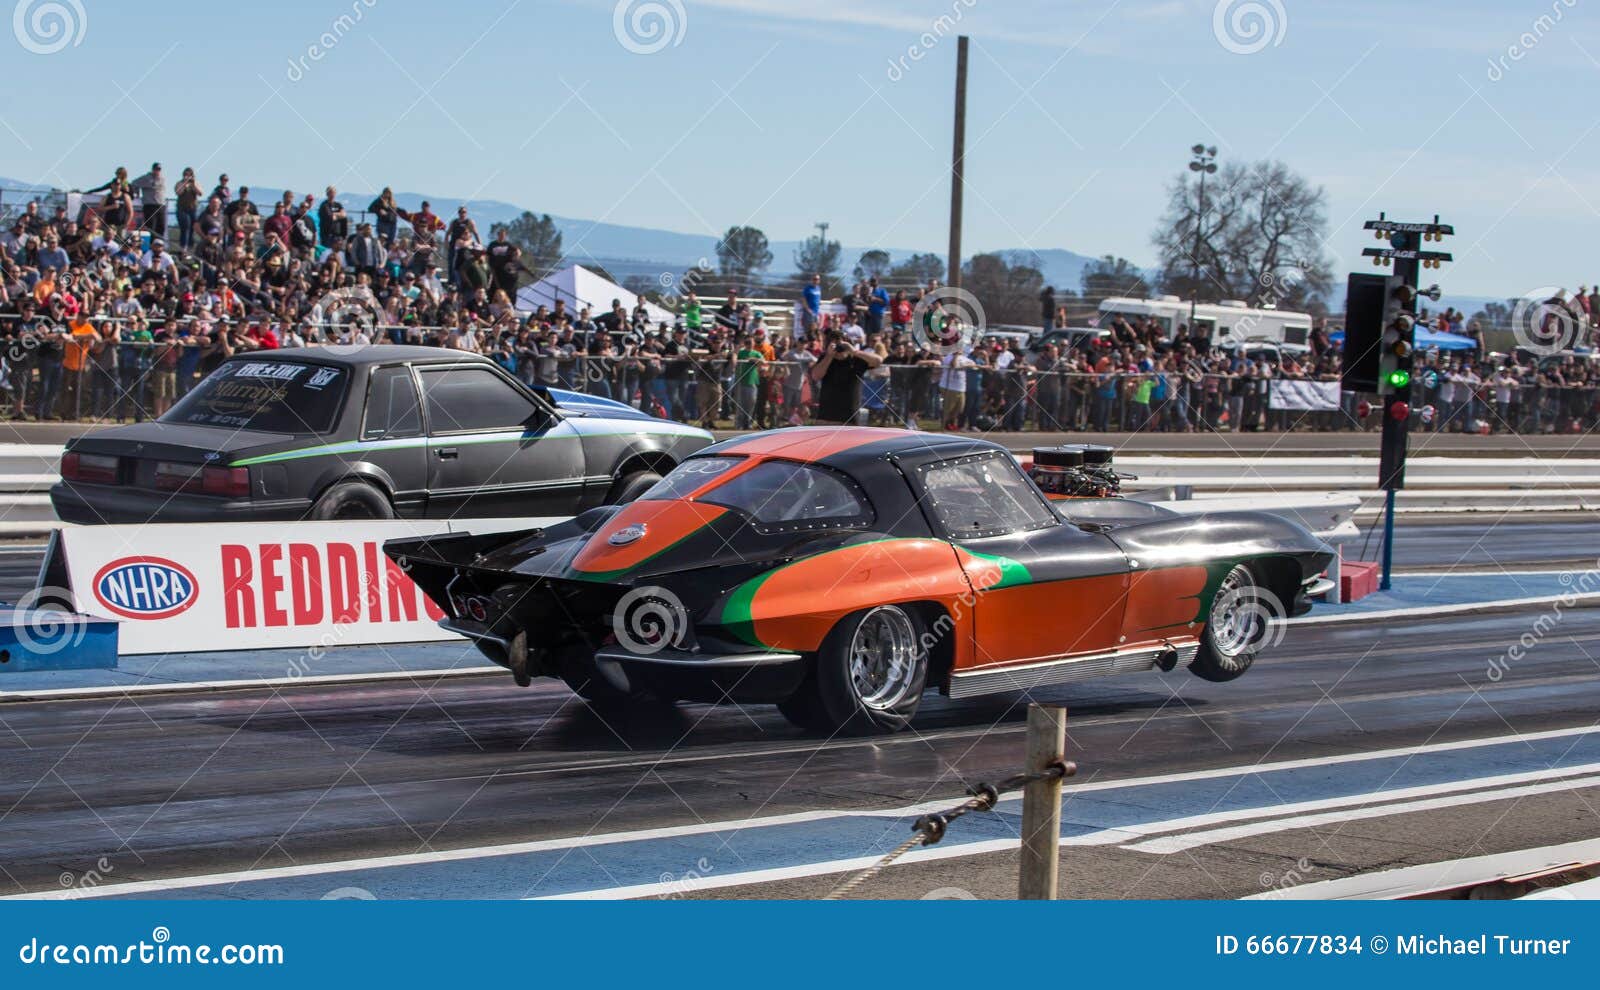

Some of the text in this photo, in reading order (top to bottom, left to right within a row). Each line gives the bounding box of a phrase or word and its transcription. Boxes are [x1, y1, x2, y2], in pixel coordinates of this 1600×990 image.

[1372, 222, 1428, 232] PRE-STAGE
[1381, 249, 1417, 259] STAGE
[107, 565, 187, 610] NHRA
